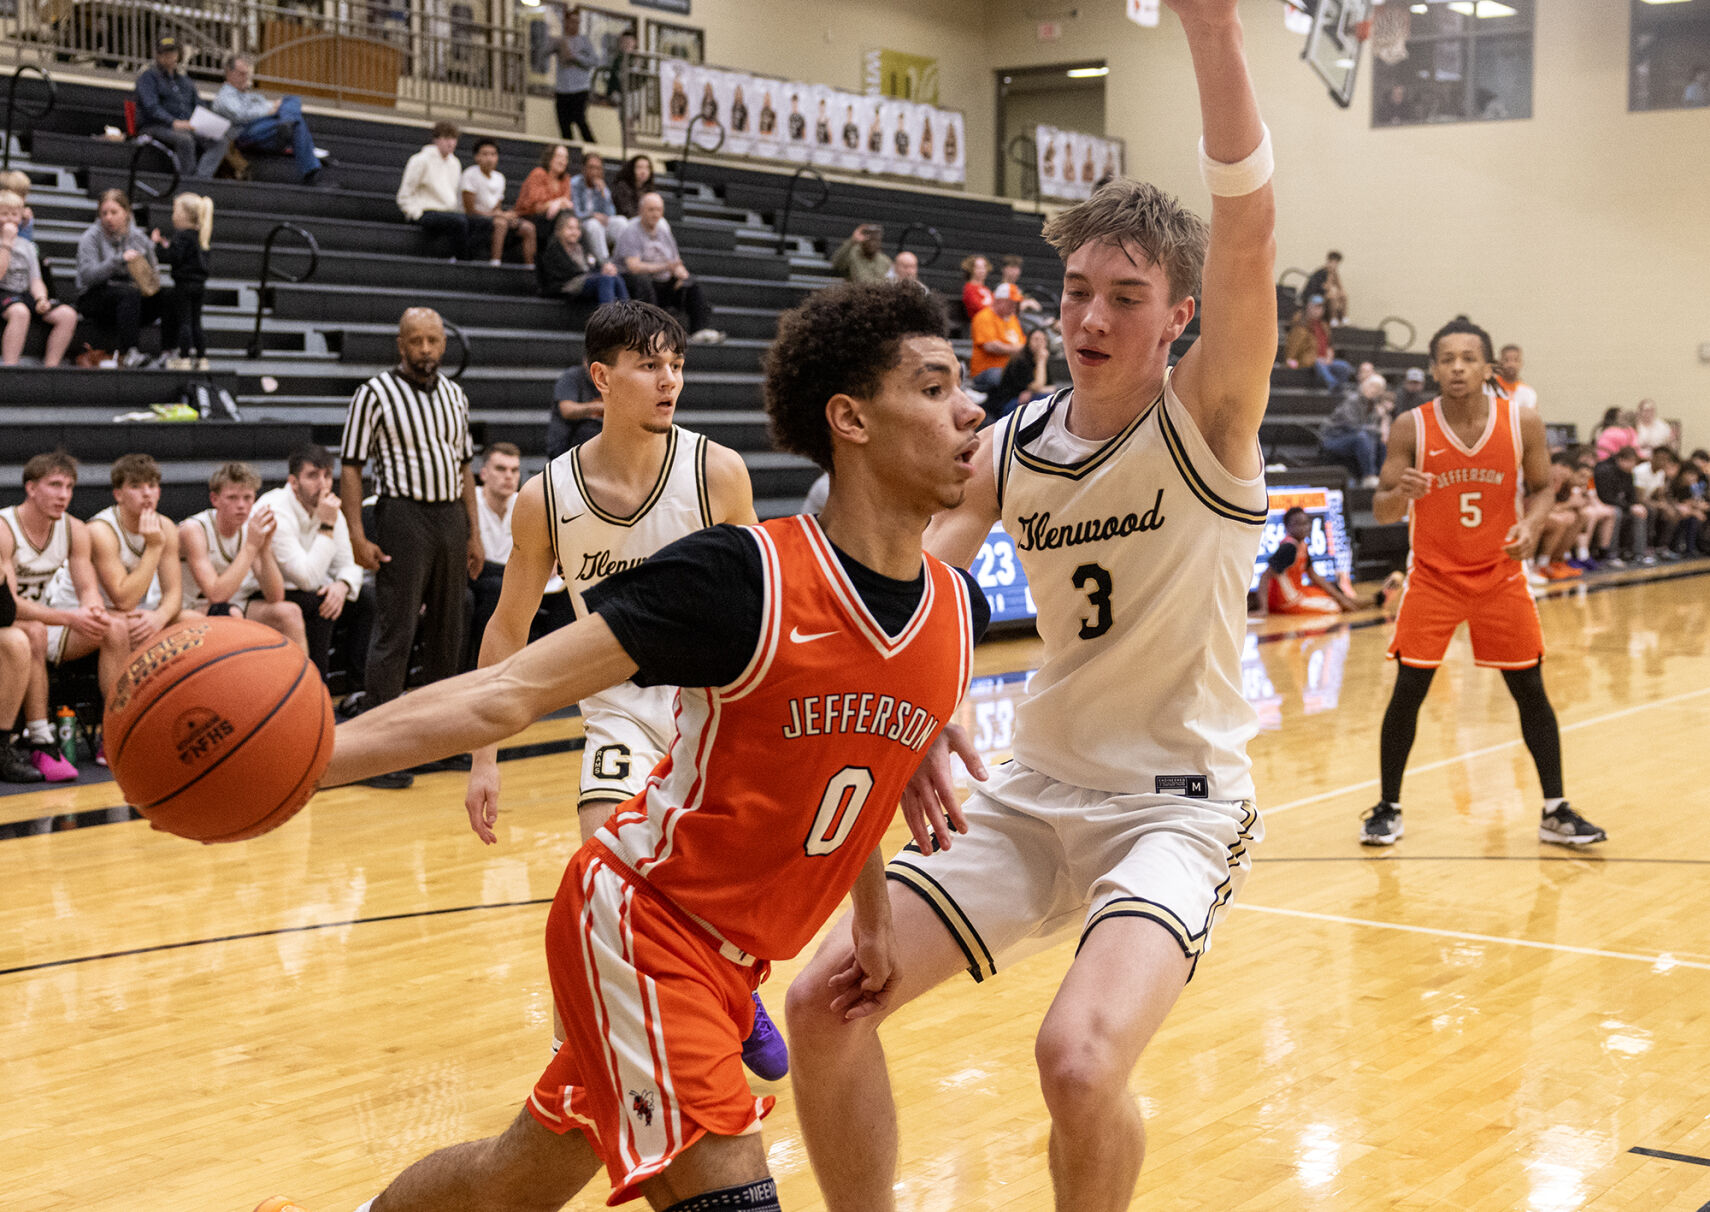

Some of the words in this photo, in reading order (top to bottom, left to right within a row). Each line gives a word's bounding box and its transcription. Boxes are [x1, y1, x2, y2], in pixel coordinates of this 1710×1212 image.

[1436, 466, 1505, 489] JEFFERSON
[1017, 488, 1166, 552] Glenwood
[1459, 490, 1483, 529] 5
[974, 540, 1017, 589] 23
[1070, 561, 1115, 641] 3
[782, 692, 940, 754] JEFFERSON
[592, 742, 632, 782] G
[594, 750, 603, 774] RAMS
[1191, 781, 1202, 792] M
[803, 763, 875, 858] 0
